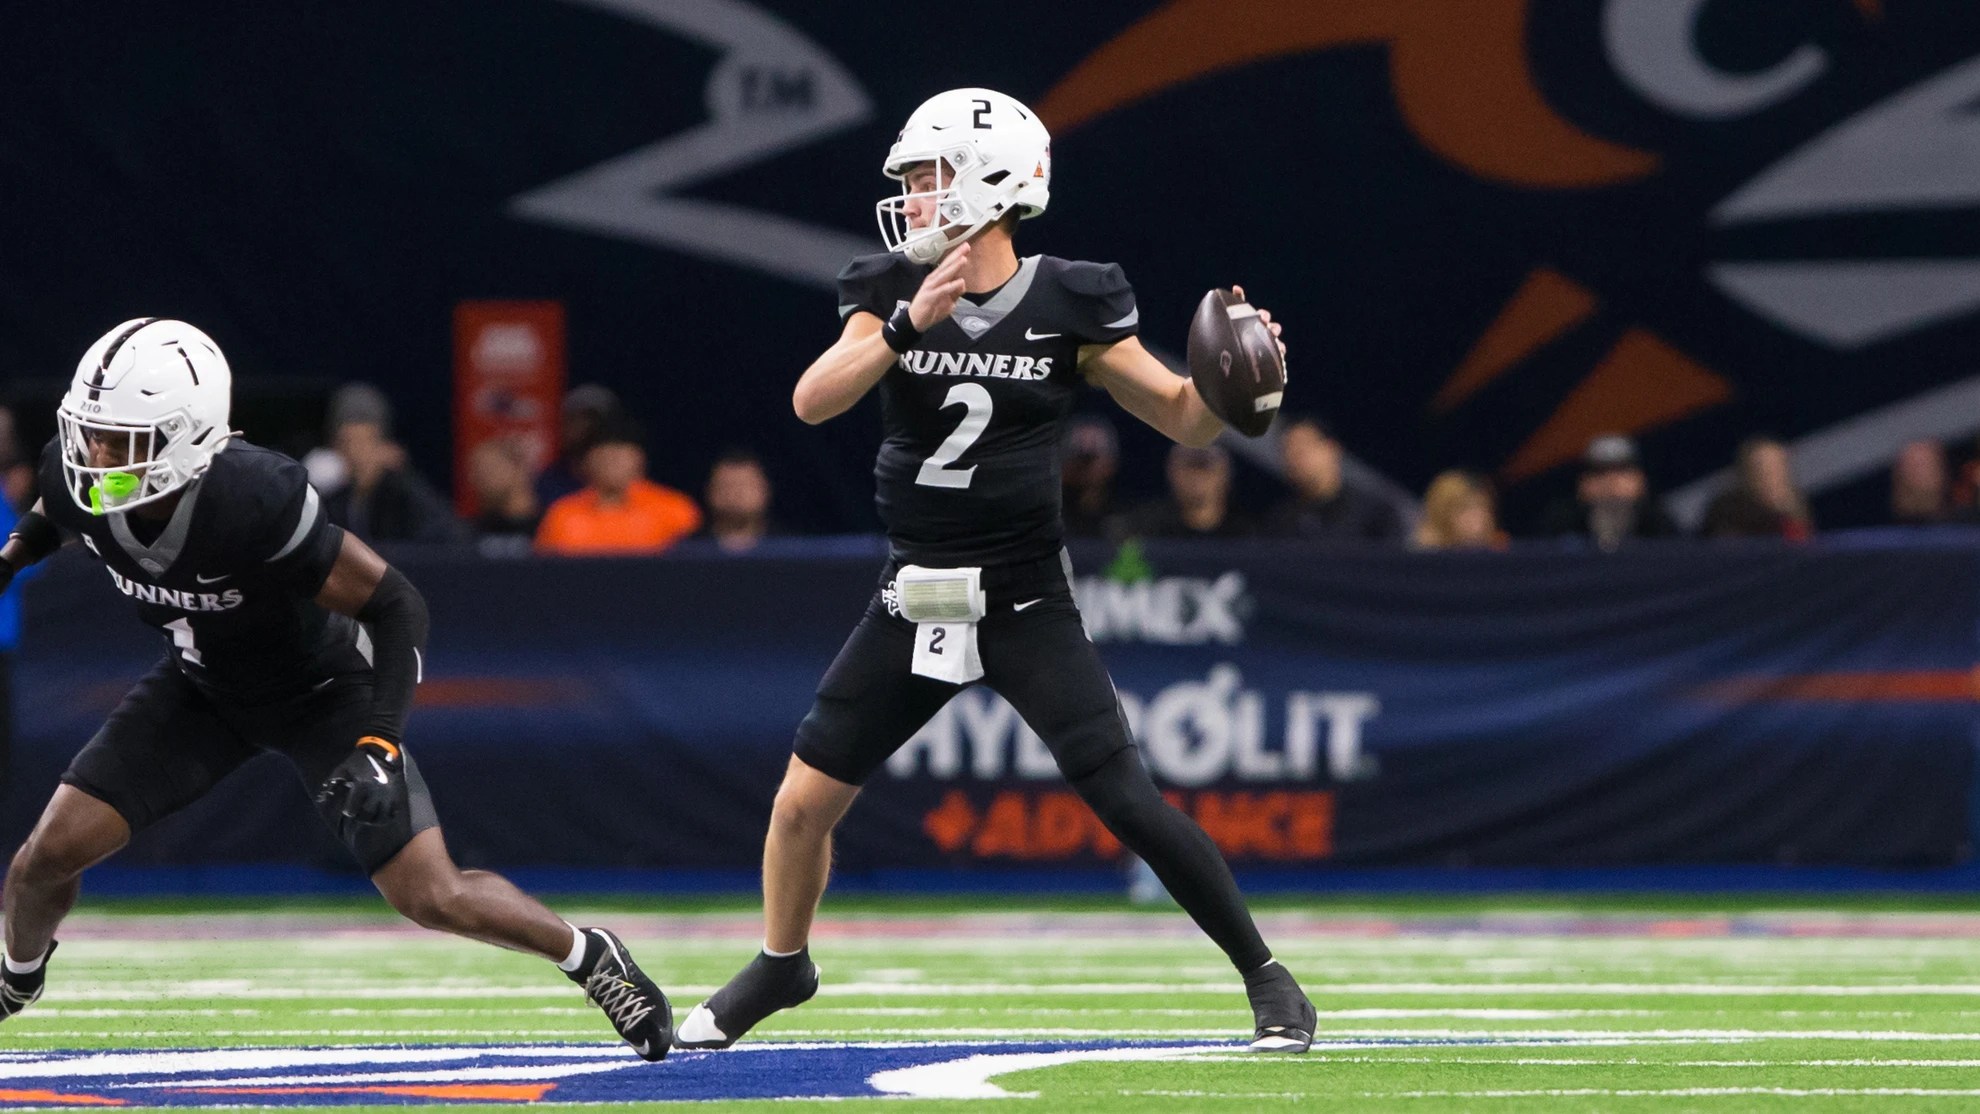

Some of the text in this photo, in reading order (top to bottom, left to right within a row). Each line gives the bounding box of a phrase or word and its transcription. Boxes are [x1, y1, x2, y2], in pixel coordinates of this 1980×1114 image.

[972, 99, 992, 129] 2
[915, 382, 993, 489] 2
[162, 617, 205, 667] 1
[929, 627, 946, 655] 2
